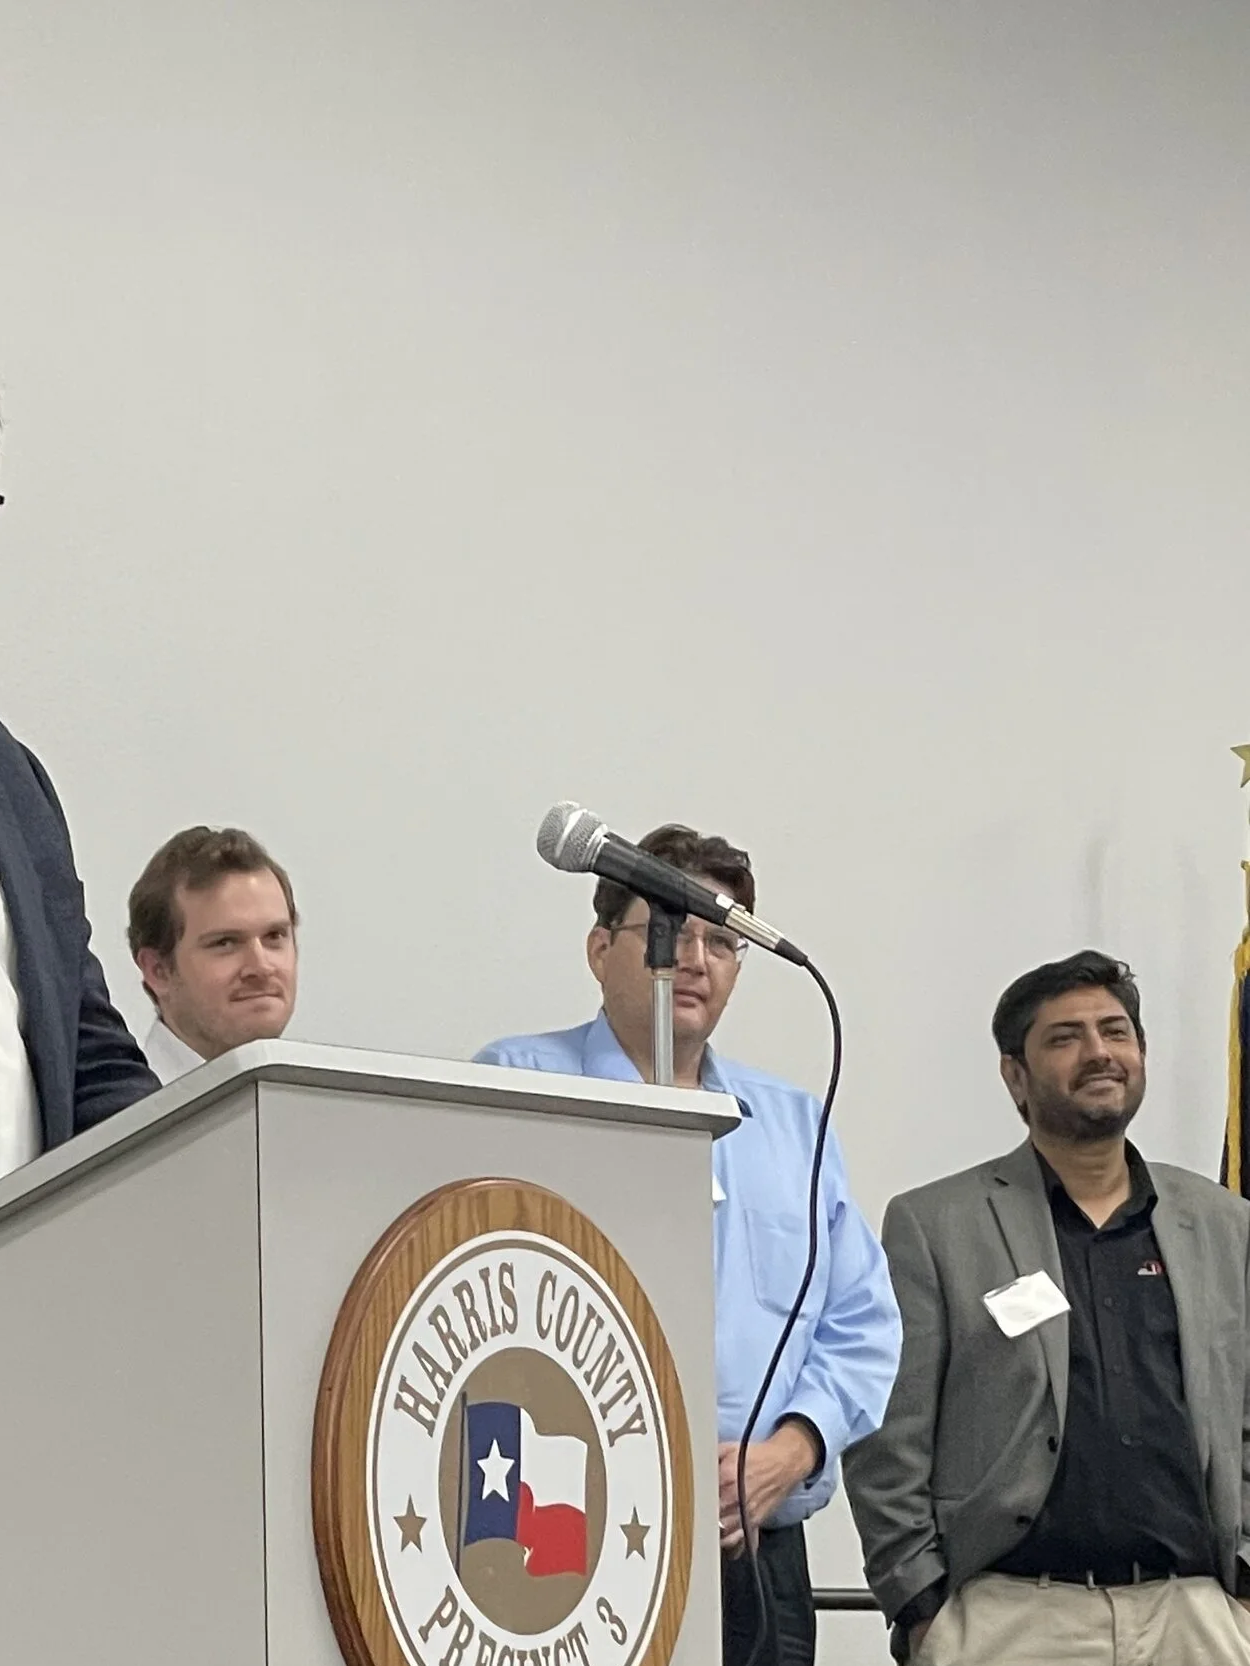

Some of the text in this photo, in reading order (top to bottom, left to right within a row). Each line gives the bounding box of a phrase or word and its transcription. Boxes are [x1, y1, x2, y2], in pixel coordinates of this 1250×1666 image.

[394, 1261, 649, 1447] HARRIS COUNTY
[597, 1596, 628, 1647] 3
